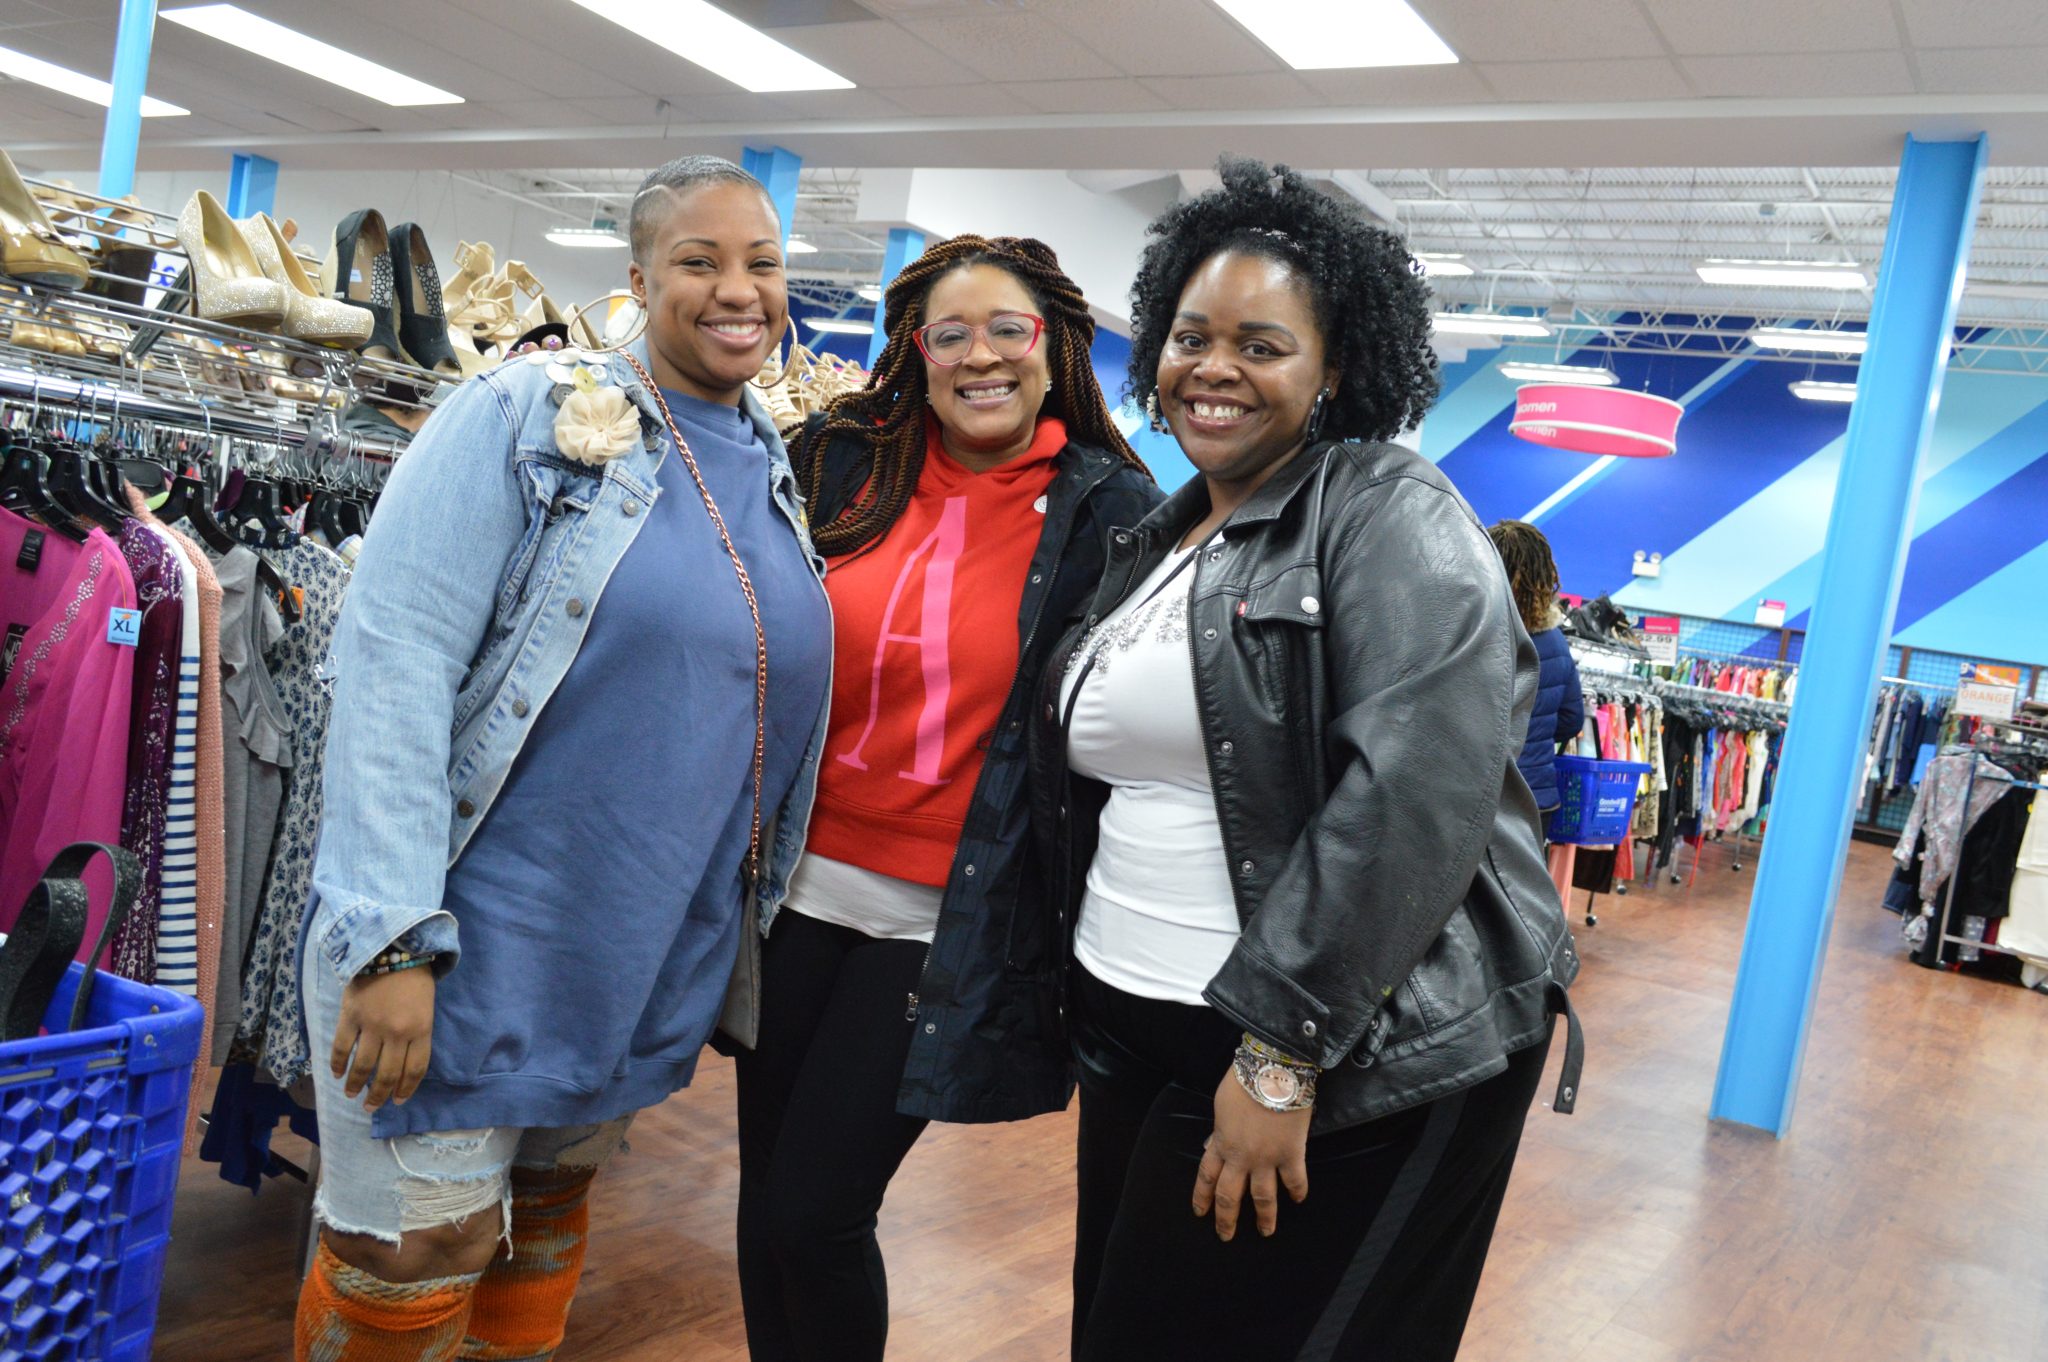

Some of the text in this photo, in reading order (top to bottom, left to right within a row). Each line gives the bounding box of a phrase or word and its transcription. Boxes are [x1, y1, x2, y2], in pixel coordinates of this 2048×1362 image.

[112, 618, 135, 634] XL
[835, 495, 968, 785] A
[1961, 689, 2011, 704] ORANGE
